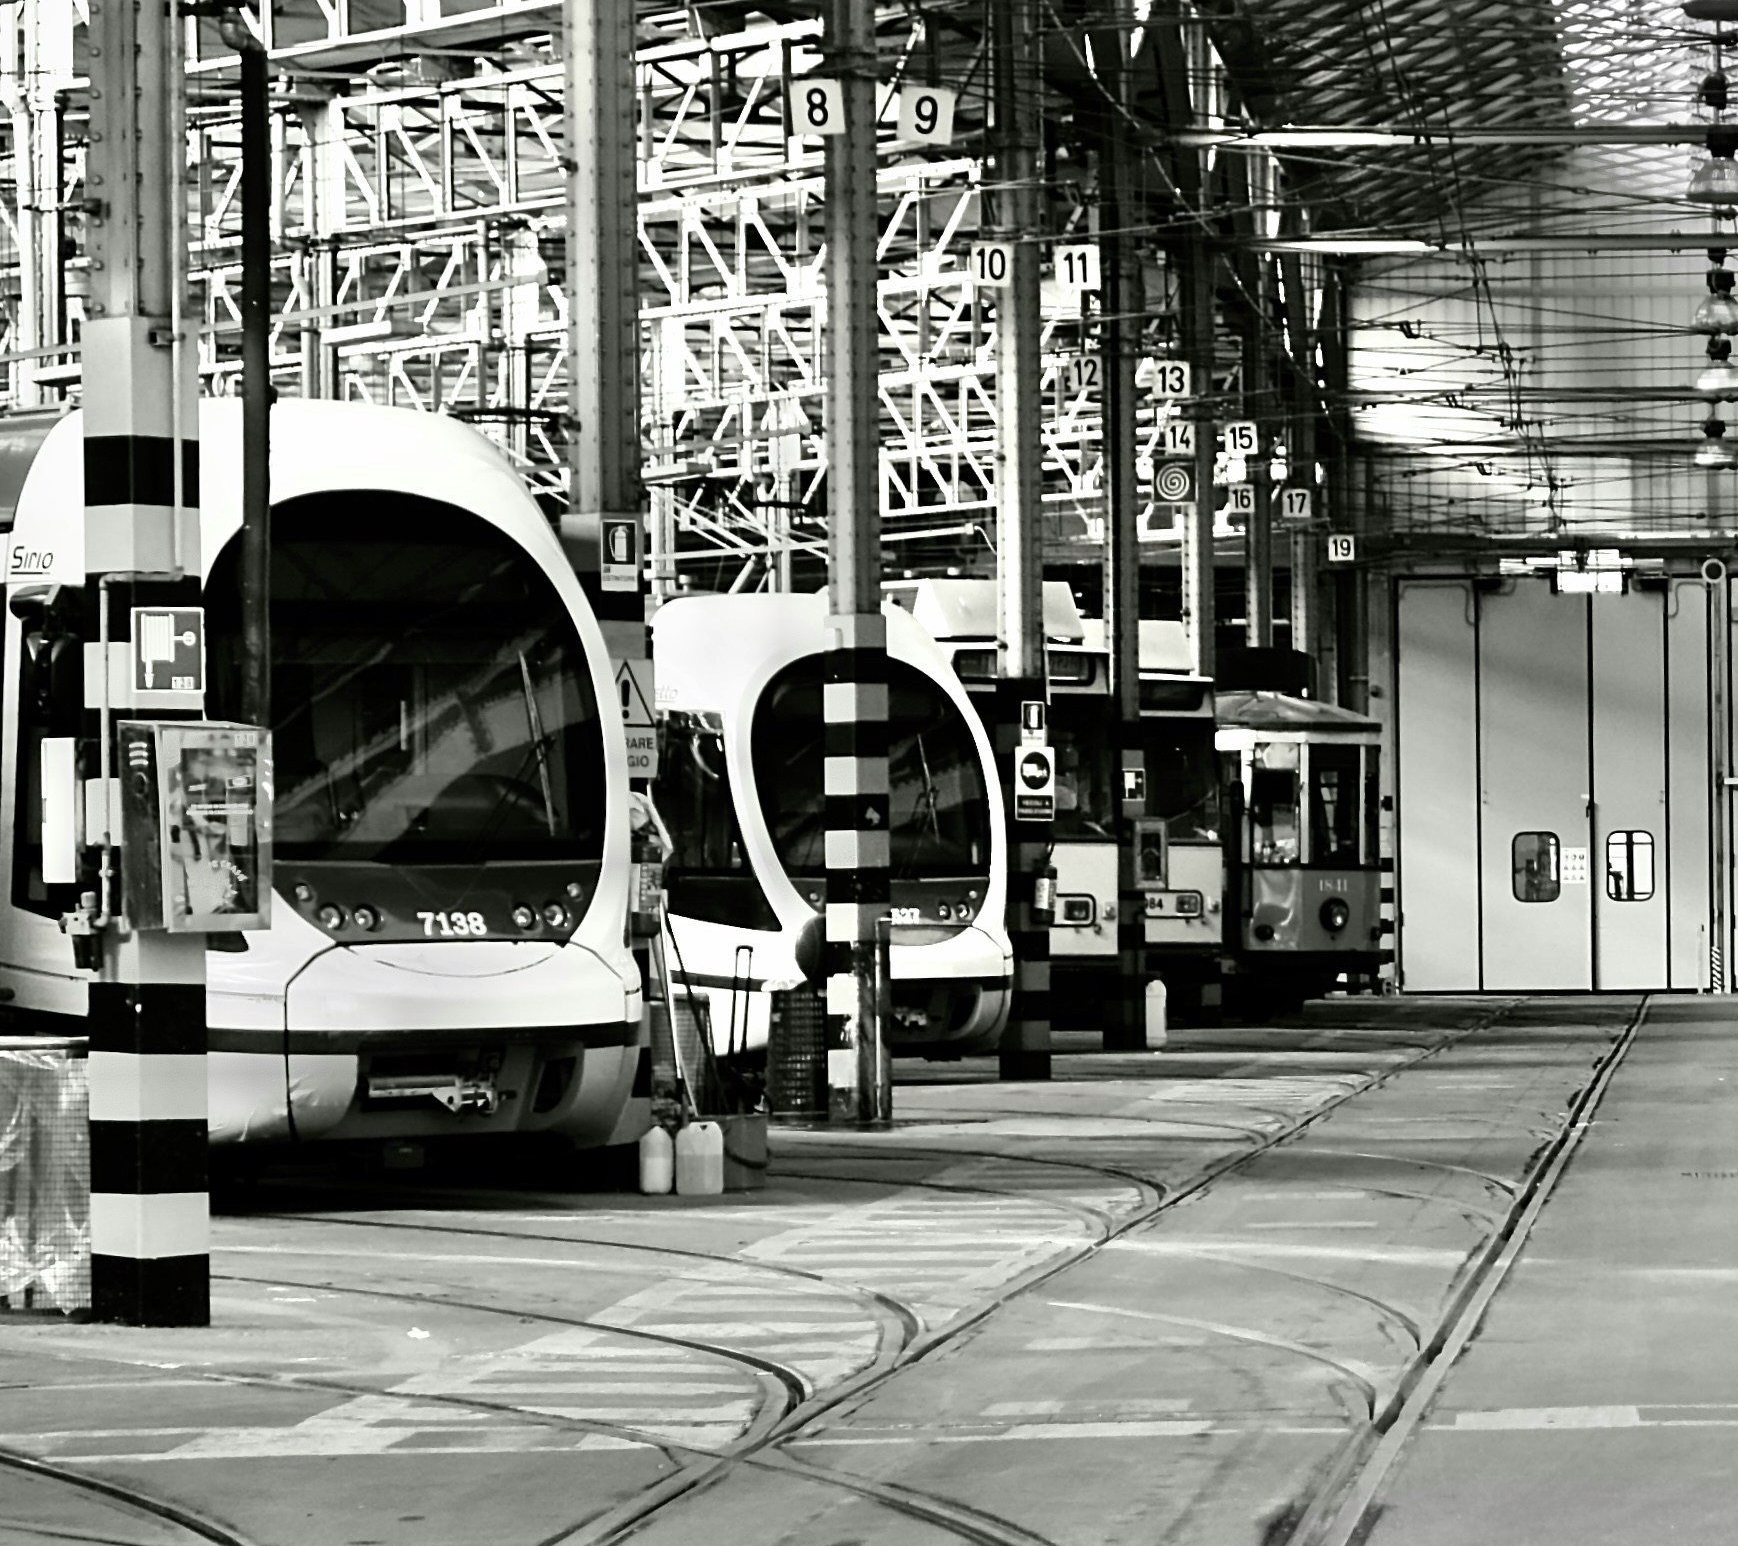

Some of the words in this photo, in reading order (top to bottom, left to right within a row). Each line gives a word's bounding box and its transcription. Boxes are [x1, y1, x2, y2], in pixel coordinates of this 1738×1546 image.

[806, 87, 829, 127] 8
[914, 93, 938, 135] 9
[976, 247, 1006, 281] 10
[1063, 251, 1088, 284] 11
[1073, 358, 1099, 387] 12
[1157, 365, 1185, 394] 13
[1169, 424, 1191, 450] 14
[1229, 425, 1253, 450] 15
[1232, 488, 1251, 509] 16
[1286, 492, 1307, 514] 17
[11, 545, 54, 570] Sirio
[1332, 538, 1352, 557] 19
[416, 911, 488, 936] 7138
